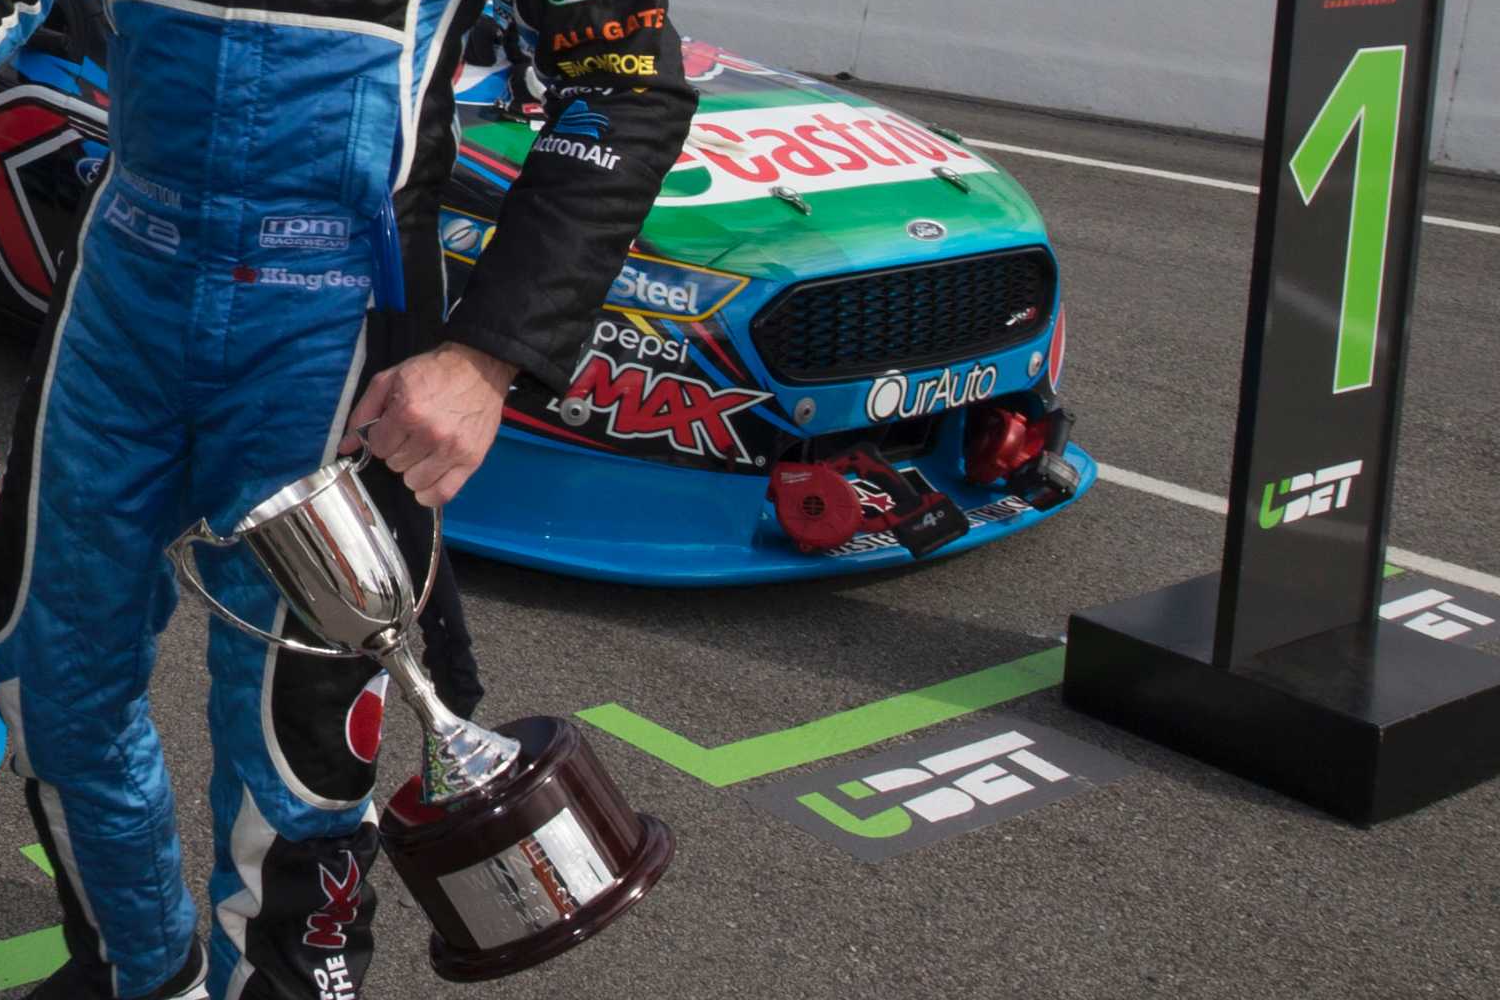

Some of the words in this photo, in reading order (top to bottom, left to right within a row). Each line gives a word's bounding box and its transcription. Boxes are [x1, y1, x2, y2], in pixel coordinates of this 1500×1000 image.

[693, 114, 972, 183] Castrol
[1288, 44, 1407, 395] 1
[260, 266, 372, 291] KingGee
[612, 266, 699, 315] Steel
[593, 321, 690, 364] pepsi
[546, 350, 775, 464] MAX
[865, 364, 997, 422] OurAuto
[1259, 459, 1364, 530] UBET
[797, 730, 1072, 839] UBET
[325, 954, 356, 1000] THE
